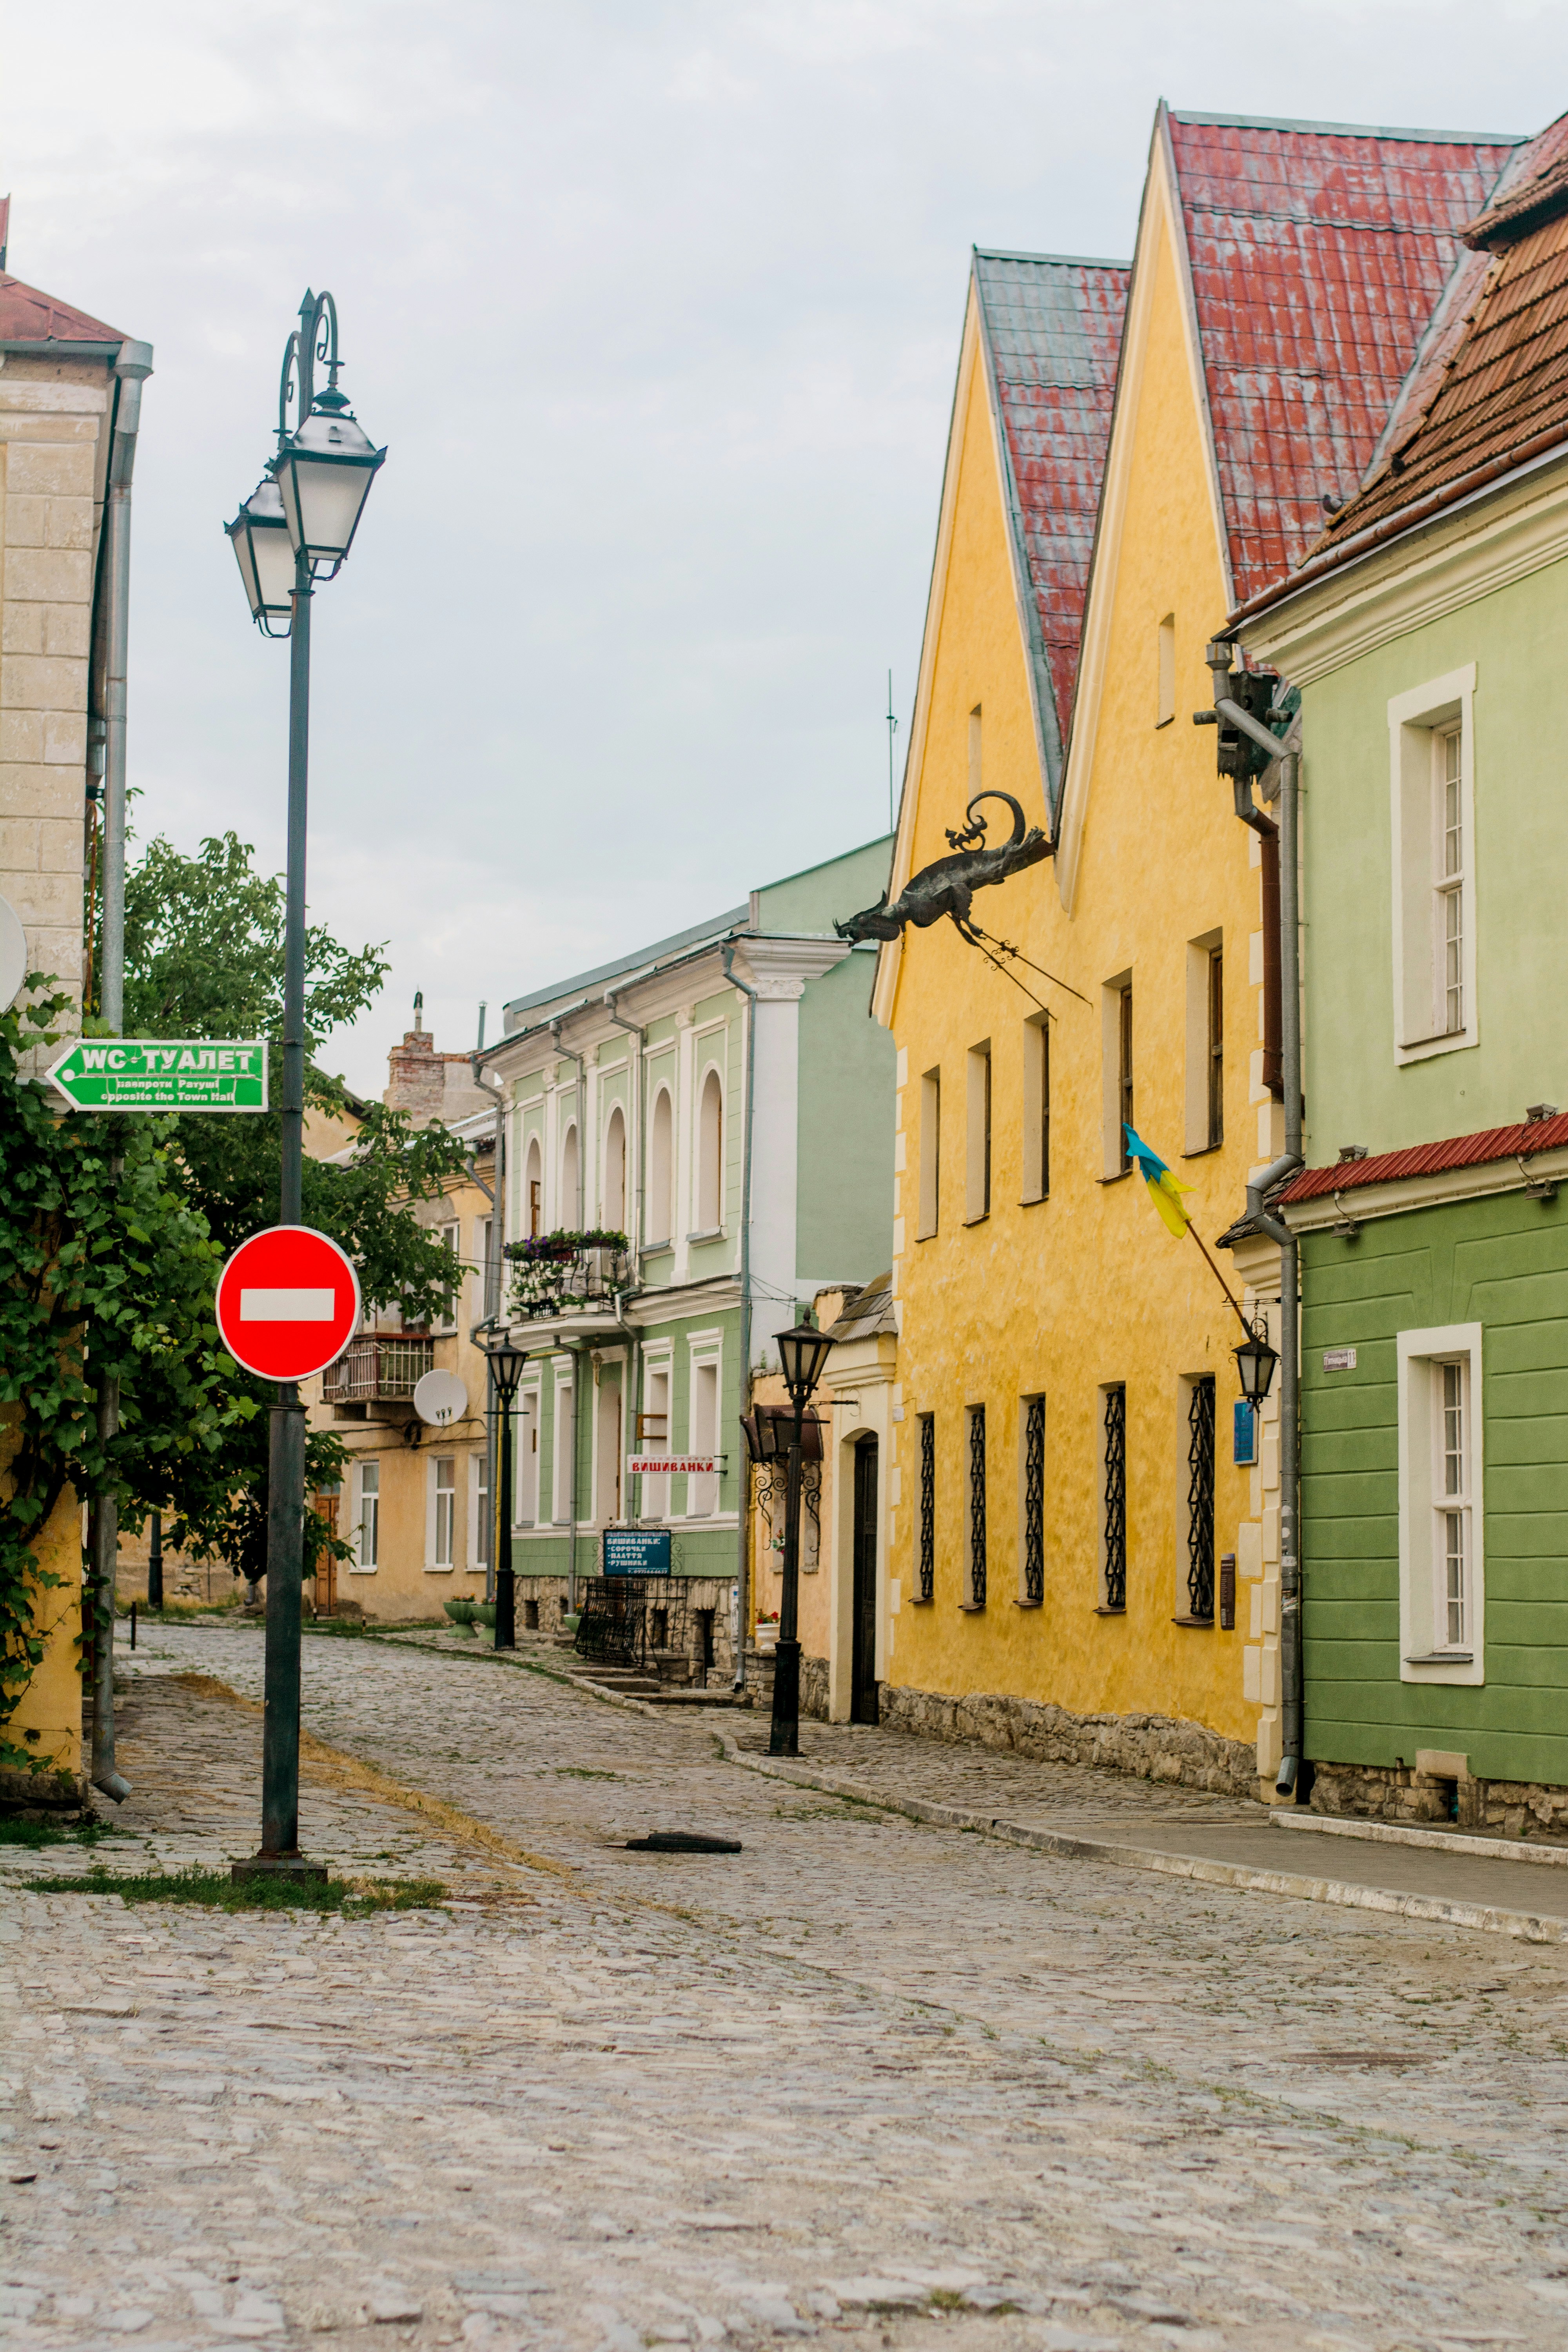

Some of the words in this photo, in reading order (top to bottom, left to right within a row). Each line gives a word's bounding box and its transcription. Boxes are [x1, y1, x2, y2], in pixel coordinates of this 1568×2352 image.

[82, 1049, 126, 1069] WC
[142, 1050, 253, 1070] ТУАЛЕТ
[178, 1080, 219, 1090] Ратуші
[101, 1093, 152, 1102] opposite
[155, 1092, 175, 1101] the
[177, 1092, 208, 1101] Town
[211, 1093, 235, 1101] Hall
[632, 1462, 713, 1472] ВИШИВАНКИ
